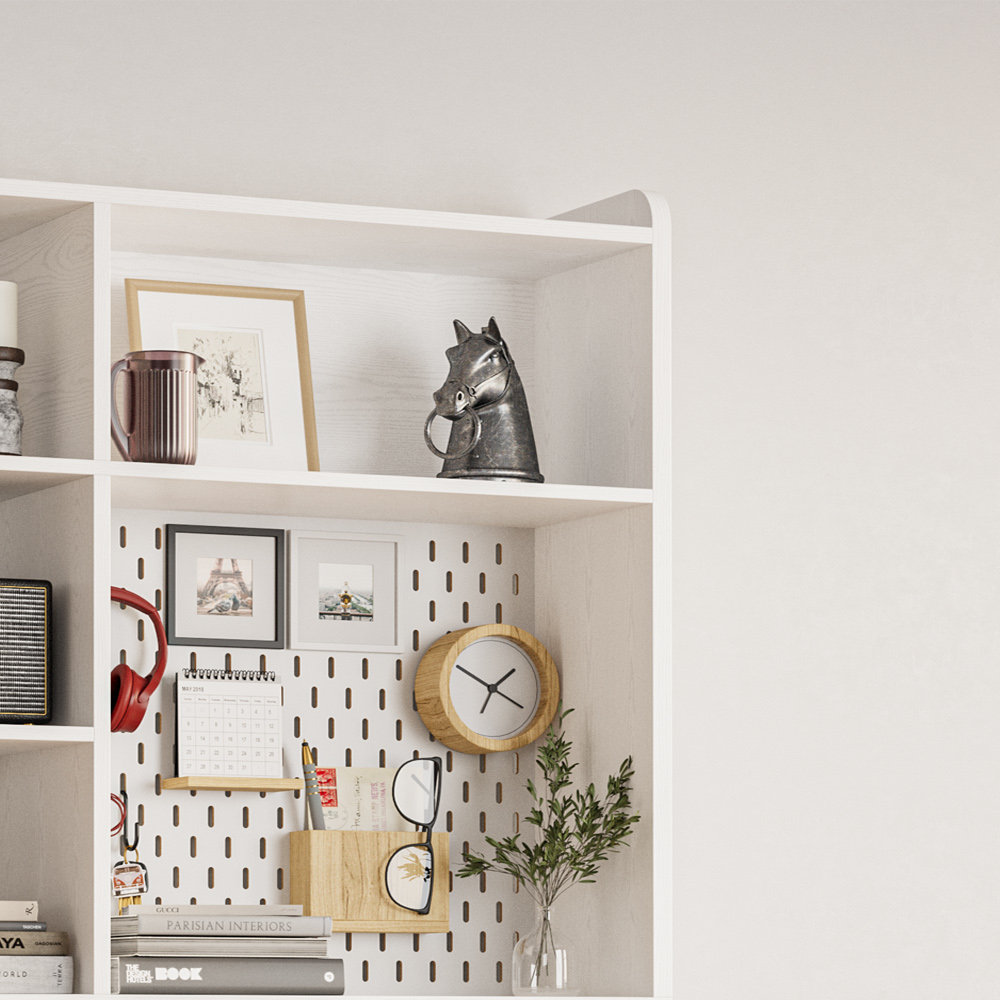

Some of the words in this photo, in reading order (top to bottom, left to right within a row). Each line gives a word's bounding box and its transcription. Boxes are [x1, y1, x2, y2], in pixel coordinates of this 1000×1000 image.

[166, 920, 225, 931] PARISIAN
[229, 921, 293, 932] INTERIORS
[155, 967, 203, 981] BOOK
